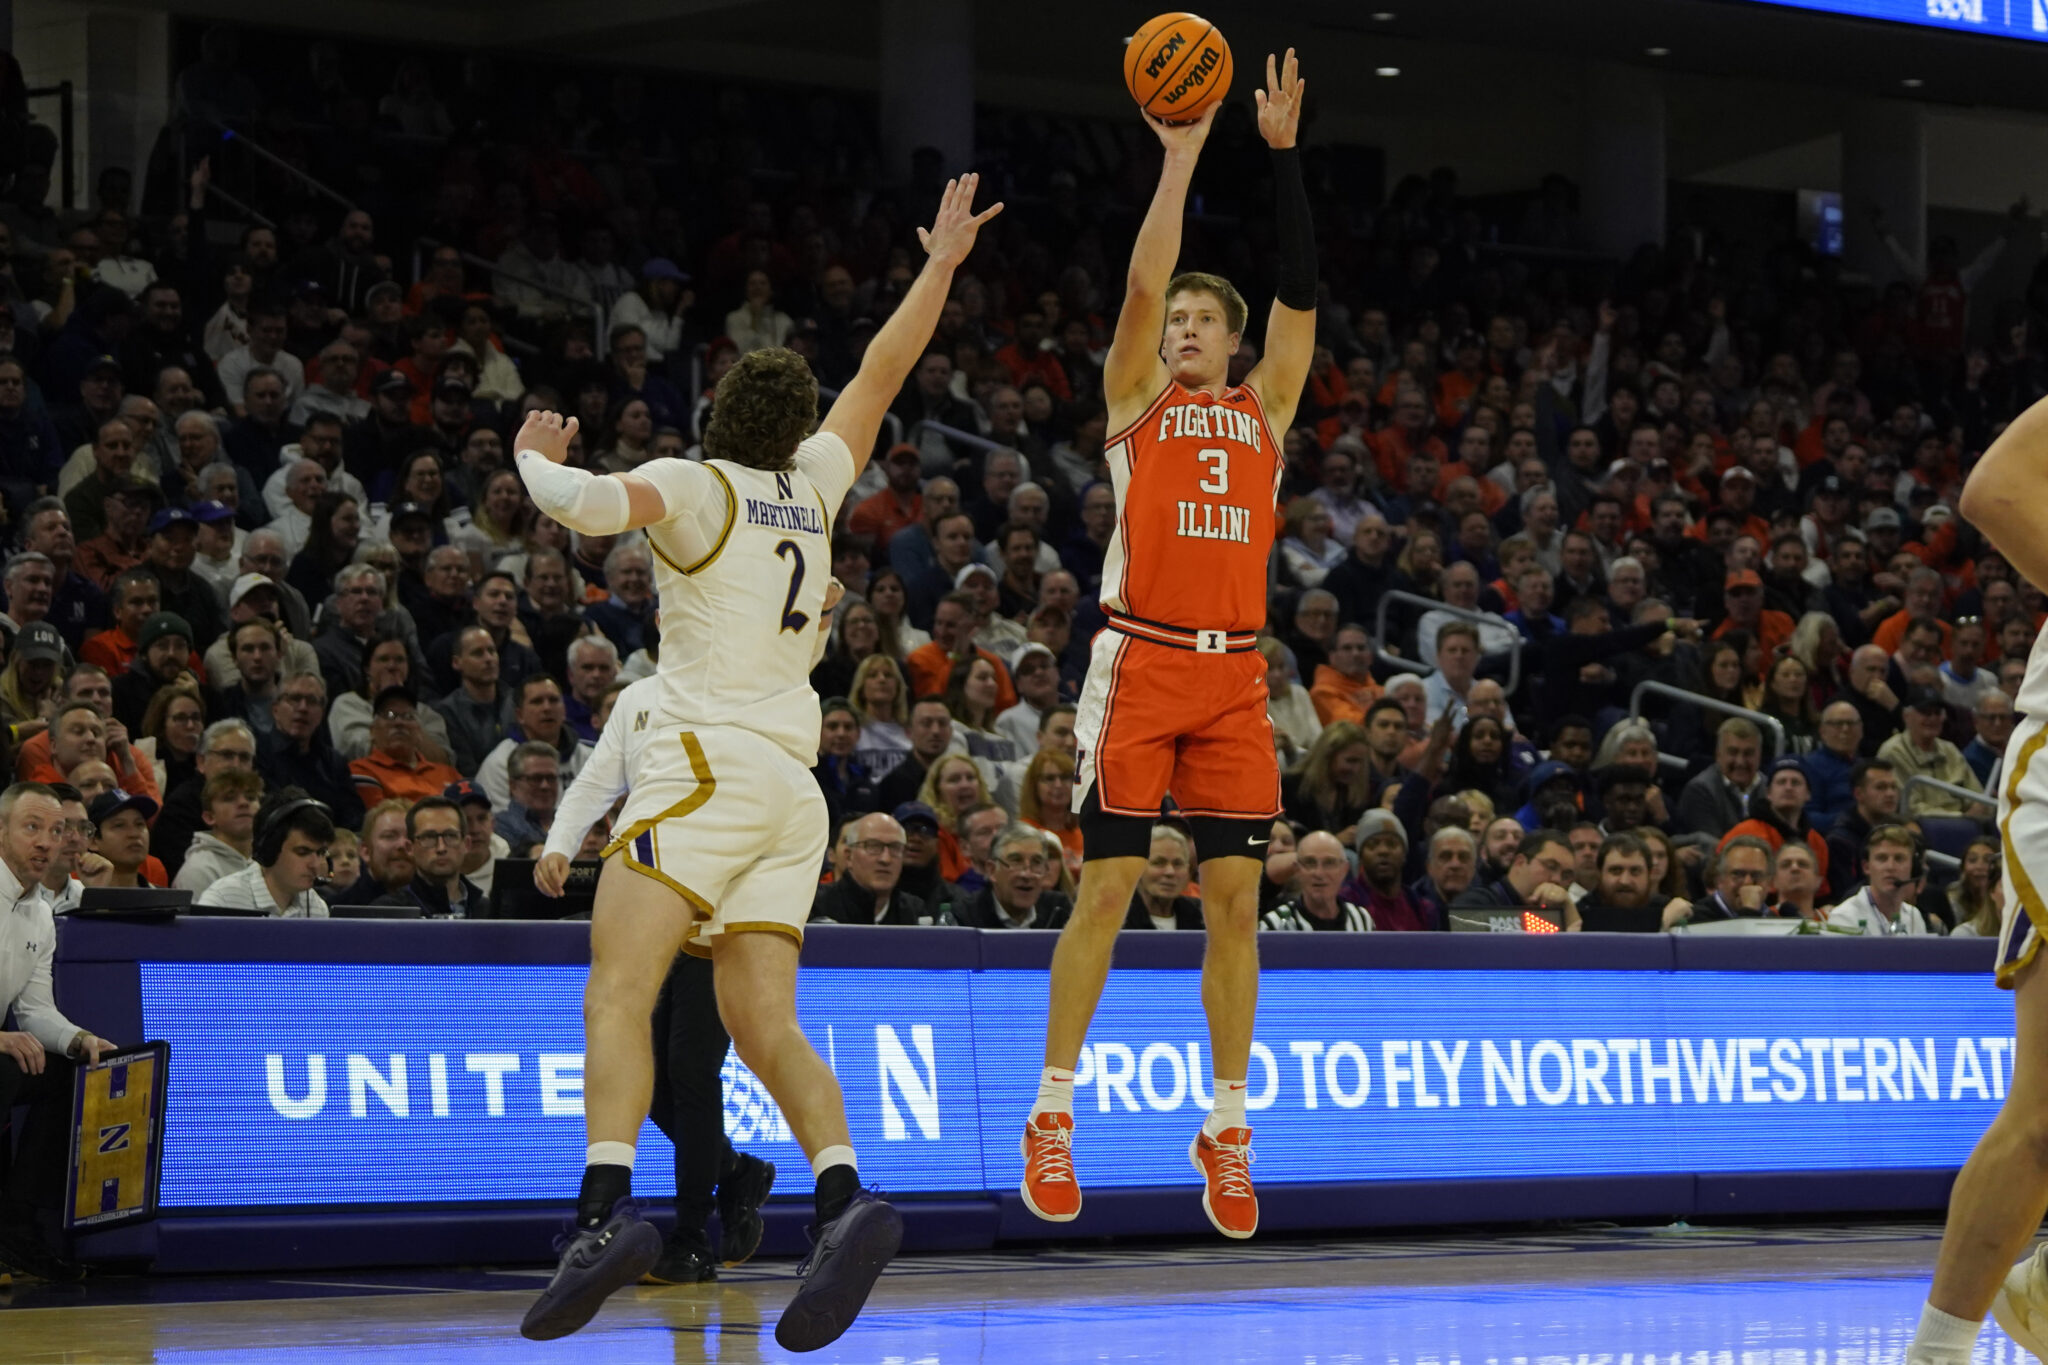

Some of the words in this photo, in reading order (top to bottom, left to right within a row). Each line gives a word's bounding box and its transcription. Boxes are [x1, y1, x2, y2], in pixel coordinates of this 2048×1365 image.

[1145, 31, 1186, 79] NCAA
[1162, 46, 1220, 104] Wilson
[1158, 403, 1262, 455] FIGHTING
[775, 472, 794, 500] N
[1198, 448, 1229, 495] 3
[745, 498, 824, 535] MARTINELLI
[1177, 501, 1250, 544] ILLINI
[774, 538, 810, 636] 2
[1208, 633, 1218, 649] I
[633, 710, 649, 732] N
[266, 1053, 586, 1119] UNITE
[875, 1024, 940, 1140] N
[1289, 1041, 1371, 1109] TO
[1382, 1040, 1470, 1108] FLY
[1480, 1037, 1940, 1106] NORTHWESTERN
[1950, 1037, 2017, 1101] AT
